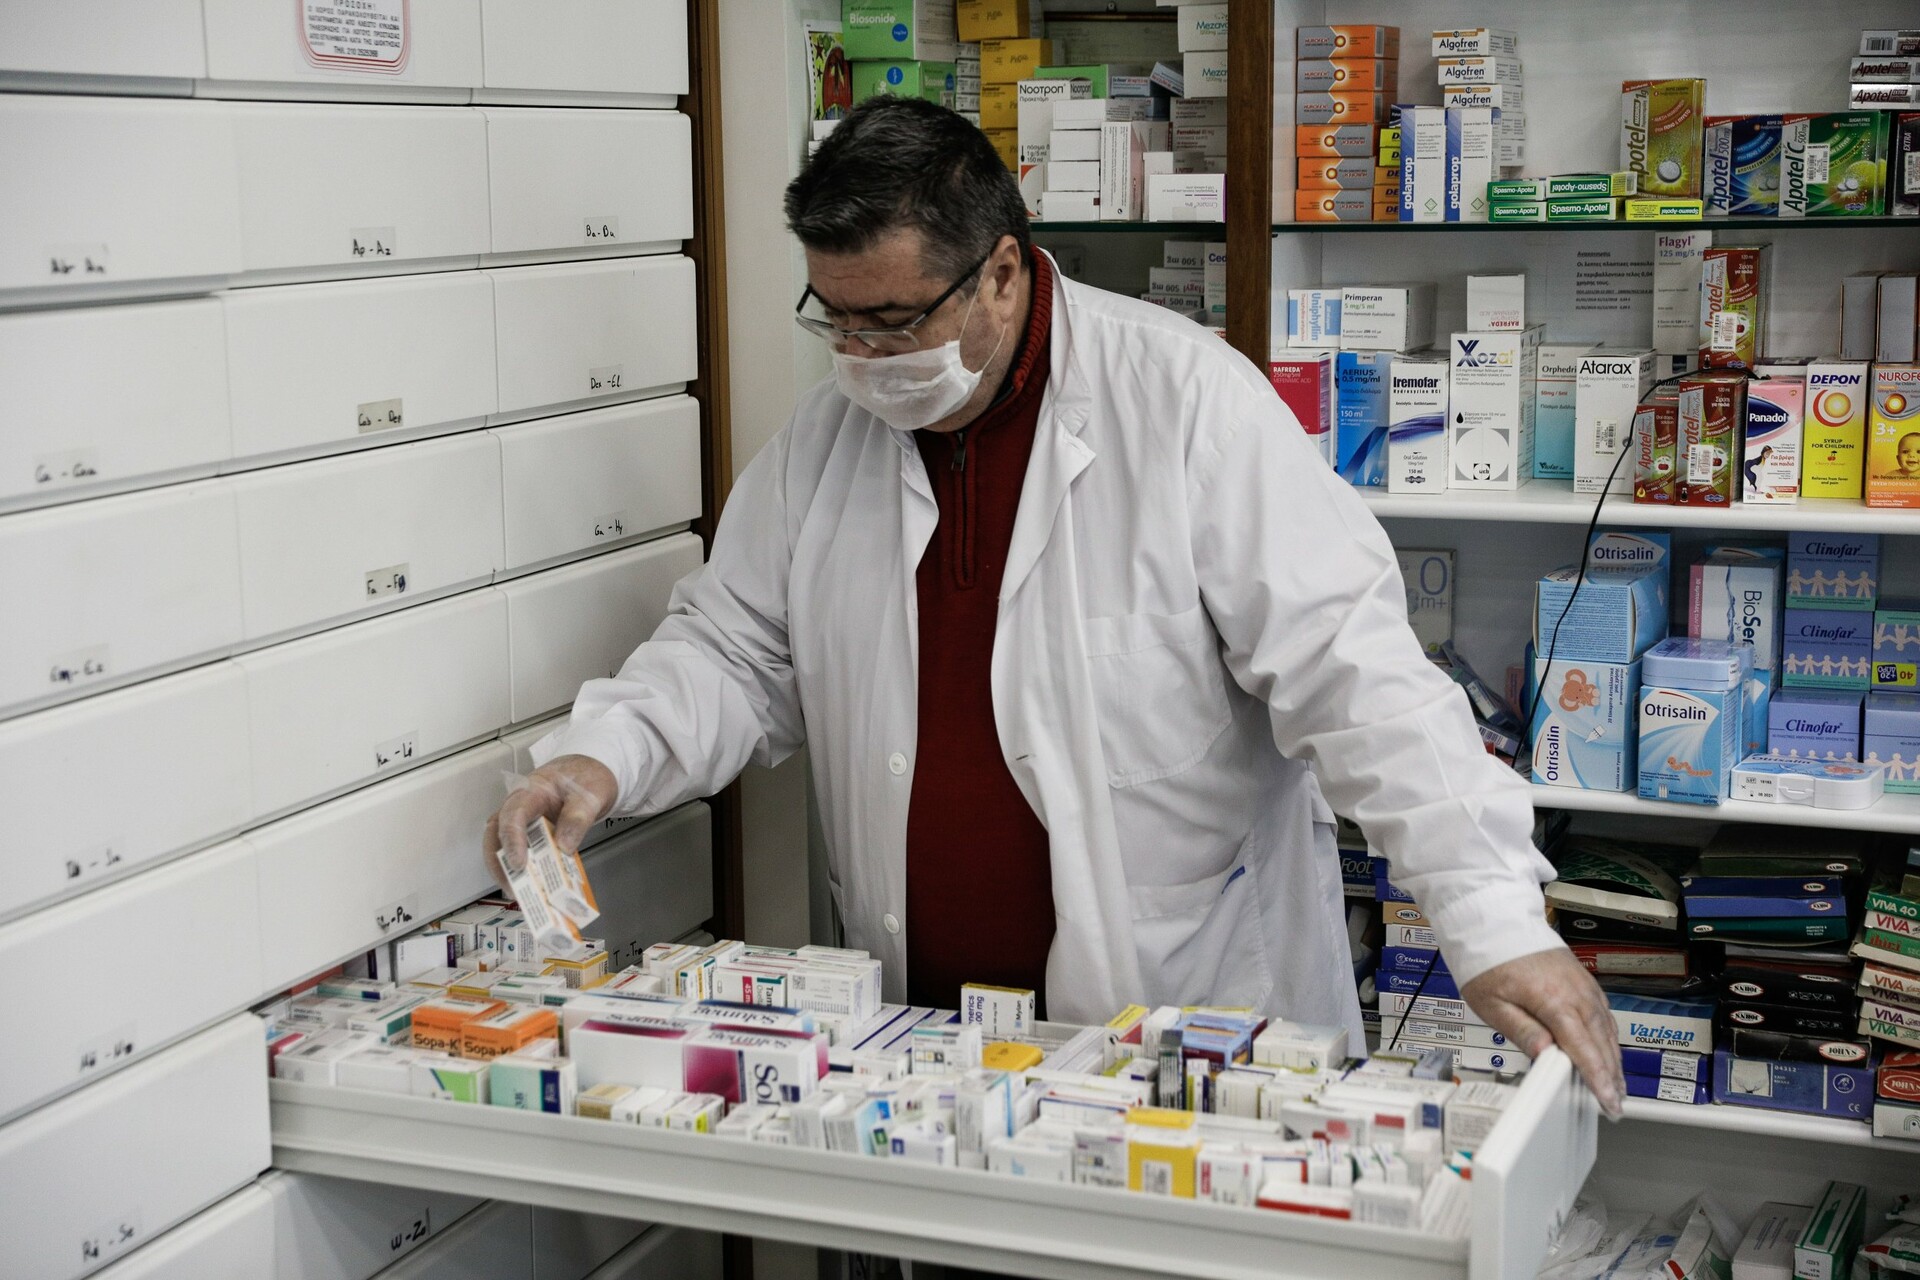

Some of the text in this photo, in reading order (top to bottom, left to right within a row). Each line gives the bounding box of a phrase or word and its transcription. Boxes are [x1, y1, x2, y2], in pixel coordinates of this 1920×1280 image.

[850, 13, 895, 24] Biosonide
[1438, 38, 1479, 50] Algofren
[1445, 66, 1485, 78] Algofren
[1855, 62, 1892, 76] Apotel
[1451, 94, 1491, 106] Algofren
[1854, 89, 1892, 104] Apotel
[1903, 132, 1911, 151] EXTRA
[1787, 142, 1806, 156] C
[1403, 156, 1414, 210] golaprop
[1450, 156, 1461, 210] golaprop
[1552, 182, 1608, 192] Spasmo-Apotel
[1708, 153, 1733, 211] Apotel
[1783, 155, 1808, 213] Apotel
[1493, 186, 1535, 195] Spasmo-Apotel
[1495, 206, 1538, 215] Spasmo-Apotel
[1550, 203, 1609, 214] Spasmo-Apotel
[1659, 235, 1691, 249] Flagyl
[1675, 249, 1695, 259] mg/5
[1344, 294, 1383, 302] Primperan
[1309, 292, 1321, 341] Uniphyllin
[1541, 365, 1577, 375] Orphedri
[1579, 360, 1632, 375] Atarax
[1355, 375, 1380, 384] mg/ml
[1393, 376, 1439, 388] Iremofar
[1810, 374, 1861, 385] DEPON
[1878, 371, 1920, 382] NUROFE
[1340, 410, 1353, 418] 150
[1749, 413, 1787, 422] Panadol
[1875, 422, 1897, 436] 3+
[1638, 431, 1653, 470] Apotel
[1594, 546, 1655, 560] Otrisalin
[1805, 542, 1863, 558] Clinofar
[1800, 624, 1857, 641] Clinofar
[1899, 671, 1914, 679] 40
[1644, 703, 1707, 720] Otrisalin
[1785, 719, 1843, 736] Clinofar
[1546, 725, 1560, 781] Otrisalin
[1872, 897, 1918, 917] VIVA 40
[1876, 913, 1910, 933] VIVA
[1874, 974, 1904, 991] VIVA
[1870, 986, 1900, 1002] VIVA
[976, 996, 985, 1010] mg
[1875, 1007, 1904, 1025] VIVA
[1629, 1022, 1695, 1041] Varisan
[1868, 1018, 1898, 1037] VIVA
[1635, 1036, 1690, 1048] COLLANT ATTIVO
[1828, 1046, 1858, 1056] JOHNS
[754, 1063, 781, 1107] Sol
[1891, 1079, 1920, 1091] JOHNS
